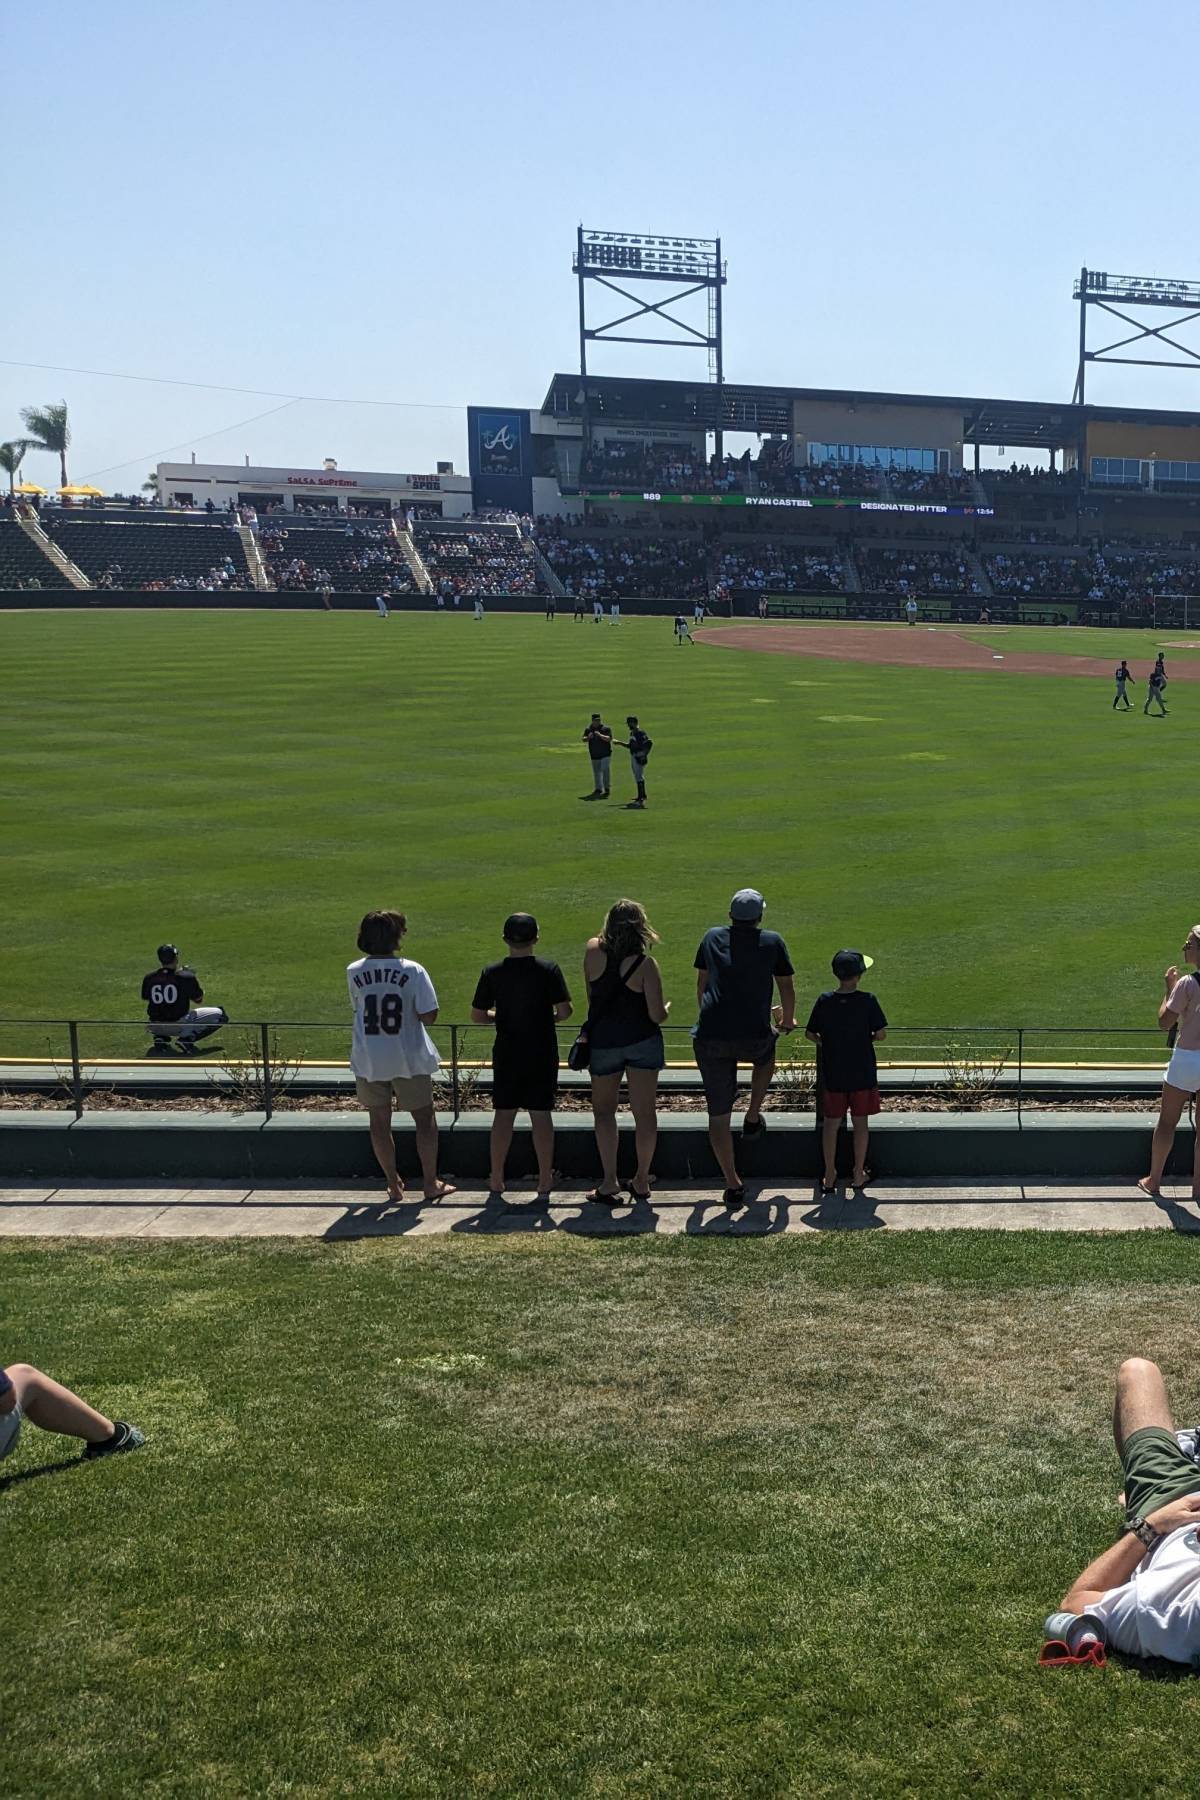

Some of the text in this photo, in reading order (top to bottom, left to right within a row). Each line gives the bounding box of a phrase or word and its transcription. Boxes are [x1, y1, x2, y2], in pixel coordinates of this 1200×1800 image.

[745, 497, 772, 506] RYAN
[772, 498, 813, 507] CASTEEL
[860, 502, 915, 512] DESIGNATED
[353, 968, 410, 989] HUNTER
[151, 984, 178, 1004] 60
